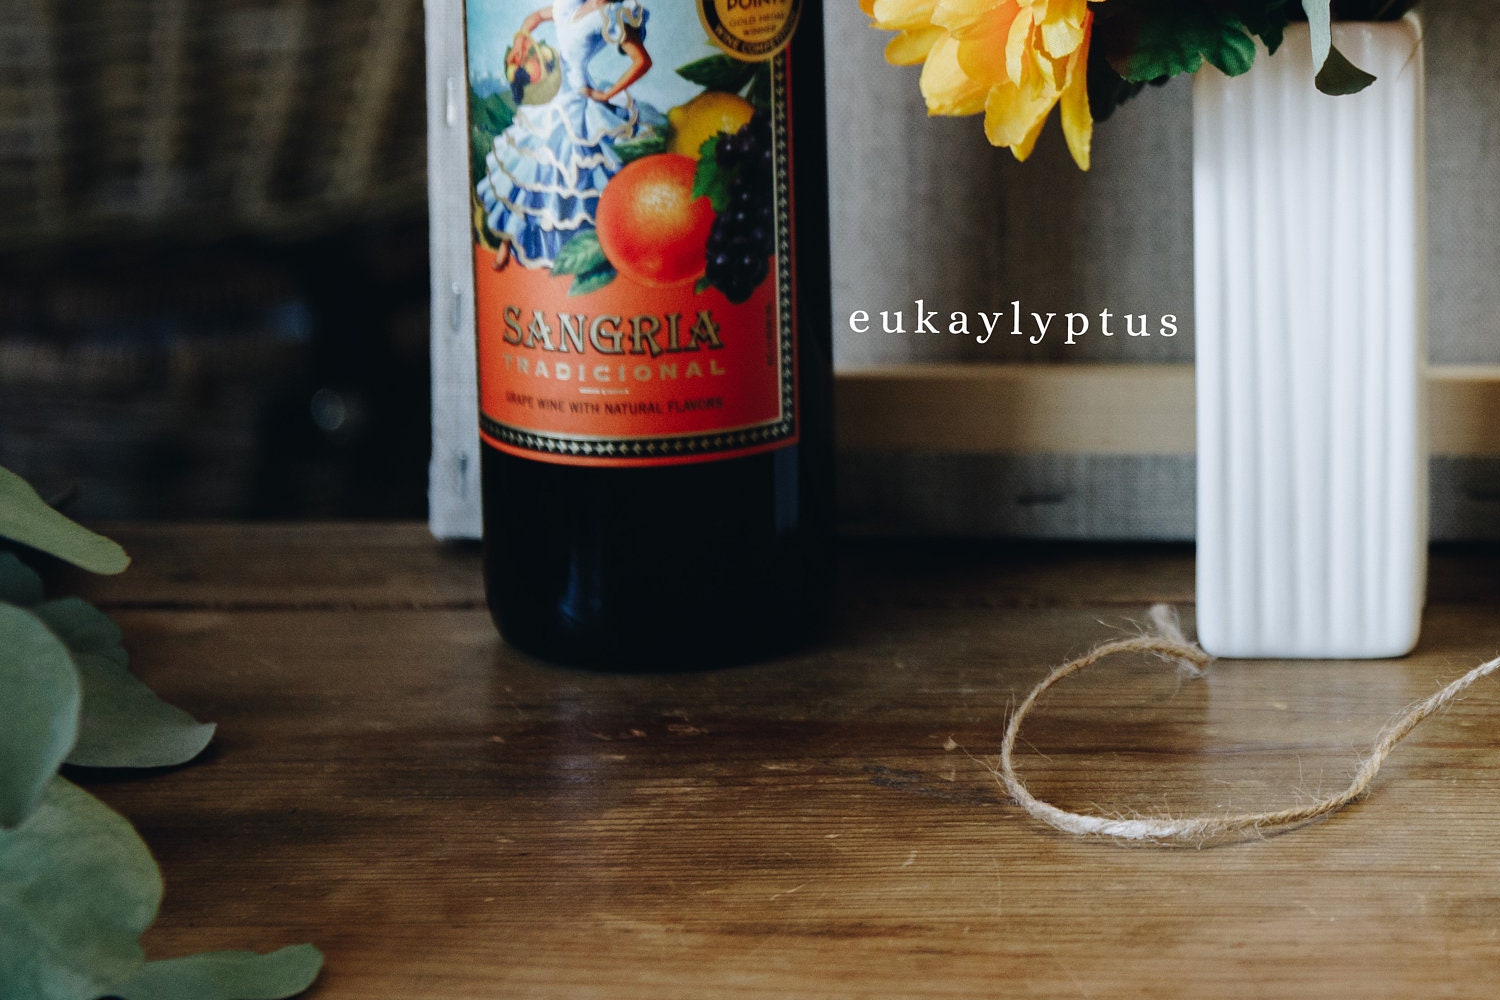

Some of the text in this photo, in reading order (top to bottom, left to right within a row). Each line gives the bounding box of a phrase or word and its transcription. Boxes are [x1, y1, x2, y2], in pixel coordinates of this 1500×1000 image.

[502, 304, 725, 359] SANGRIA
[503, 352, 726, 382] TRADICIONAL
[505, 390, 724, 415] GRAPE WINE WITH NATURAL FLAVORS
